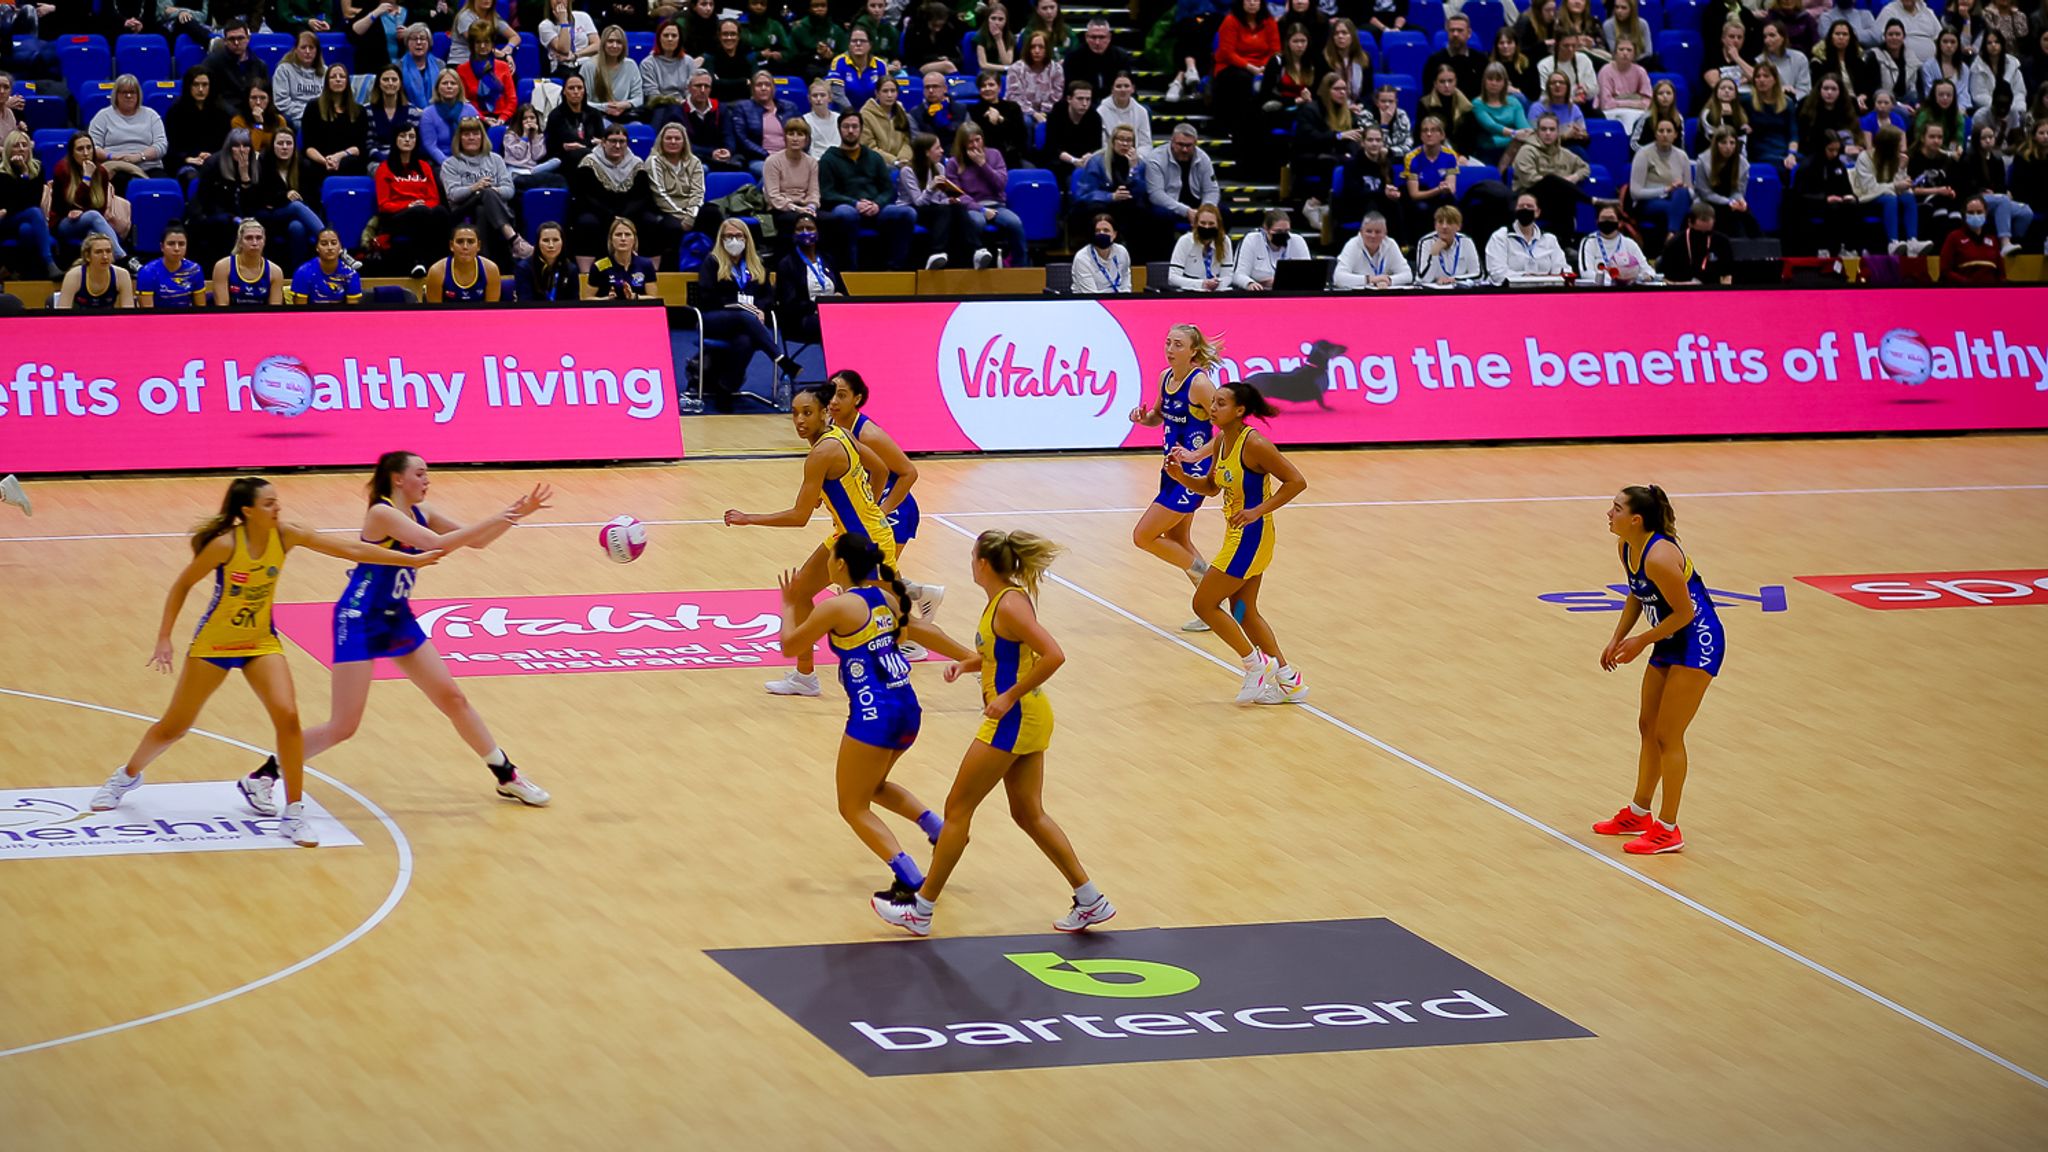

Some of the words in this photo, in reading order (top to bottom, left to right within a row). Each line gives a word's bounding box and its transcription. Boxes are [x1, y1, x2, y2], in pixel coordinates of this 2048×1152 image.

[0, 362, 120, 417] fits
[138, 359, 205, 415] of
[223, 356, 465, 424] halthy
[483, 354, 664, 419] living
[957, 333, 1118, 418] Vitality
[1412, 338, 1511, 389] the
[1525, 333, 1768, 388] benefits
[1783, 331, 1838, 383] of
[1855, 330, 2048, 392] halthy
[513, 653, 763, 671] insurance
[616, 643, 710, 656] and
[153, 834, 242, 843] Advisor
[849, 990, 1509, 1051] bartercard
